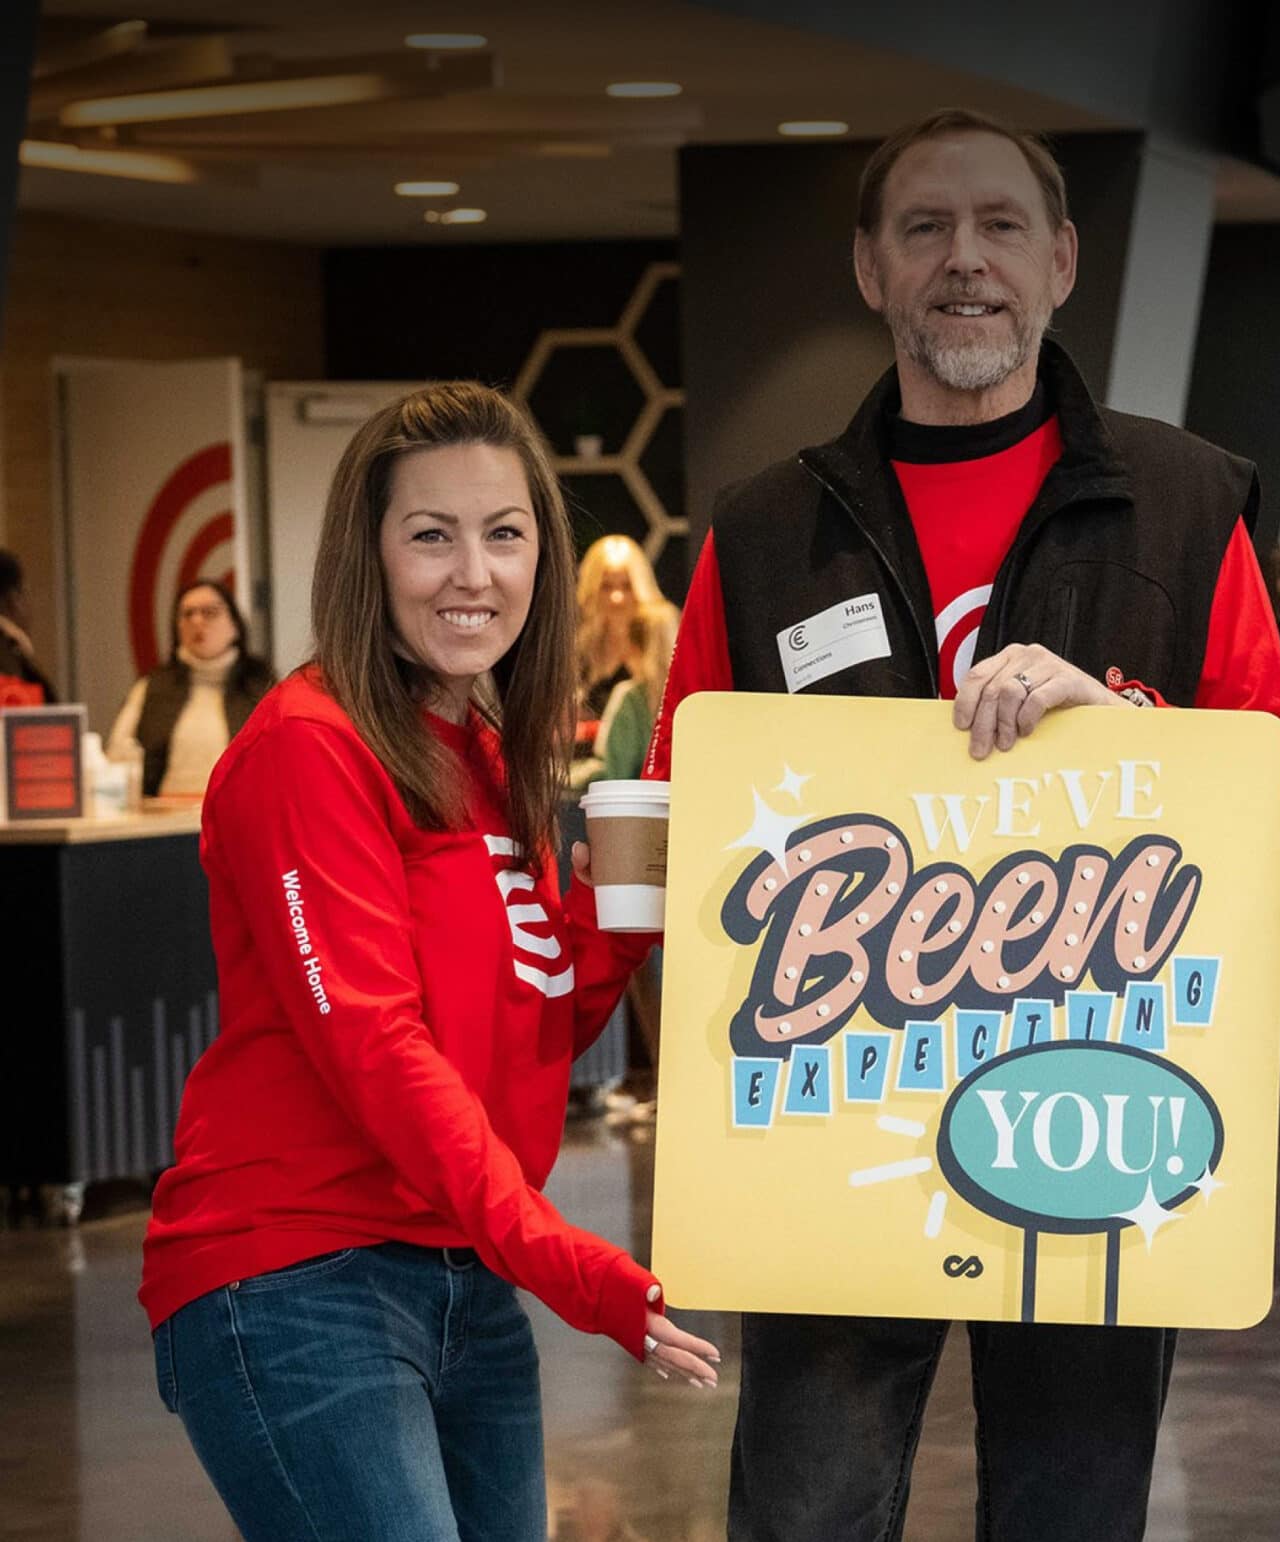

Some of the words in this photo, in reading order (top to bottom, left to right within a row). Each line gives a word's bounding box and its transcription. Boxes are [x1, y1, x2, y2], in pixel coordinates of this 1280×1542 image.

[844, 600, 876, 617] Hans
[912, 758, 1164, 854] WE'VE
[281, 869, 313, 956] Welcome
[303, 957, 332, 1016] Home
[722, 813, 1202, 1060] Been
[744, 968, 1205, 1111] EXPECTING
[976, 1089, 1187, 1175] YOU!
